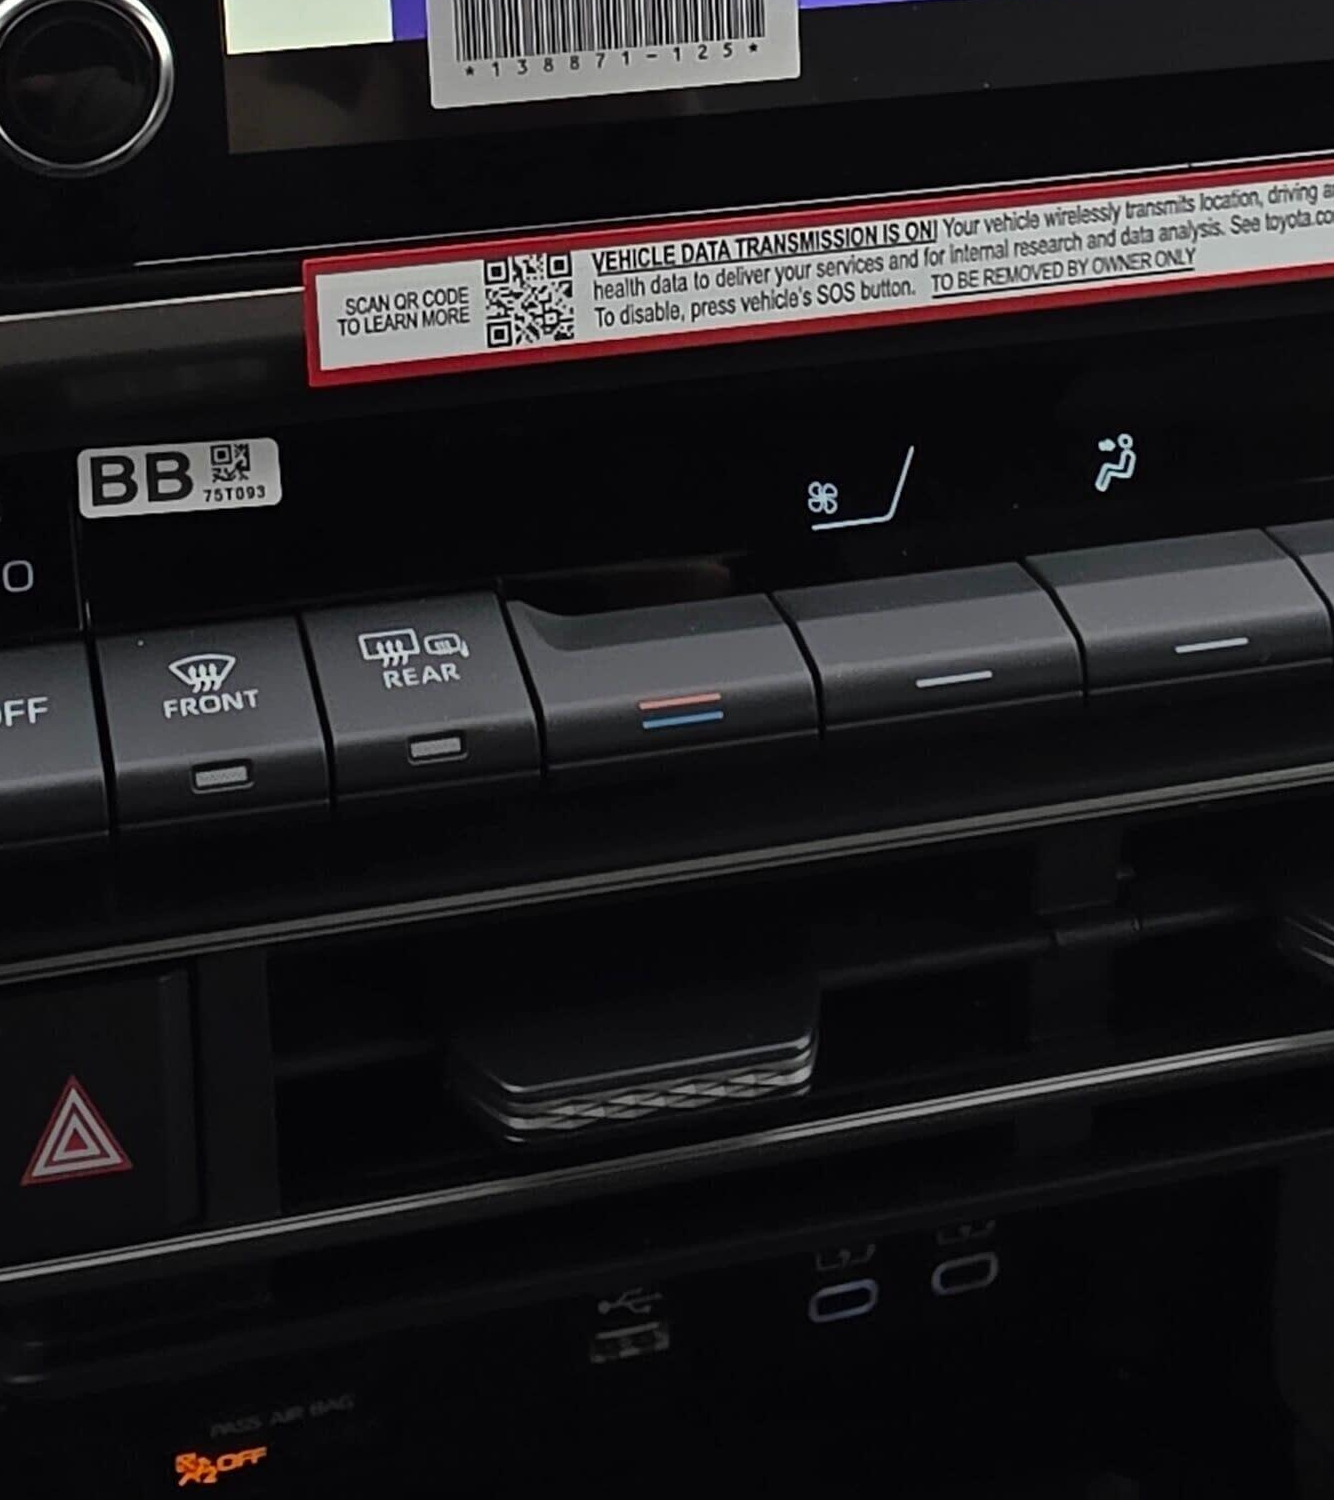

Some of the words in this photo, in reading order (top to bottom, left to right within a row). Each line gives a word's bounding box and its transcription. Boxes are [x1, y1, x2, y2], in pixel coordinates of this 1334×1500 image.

[592, 244, 675, 272] VEHICLE
[681, 240, 731, 263] DATA
[735, 225, 877, 255] TRANSMISSION
[883, 223, 900, 242] IS
[943, 218, 979, 237] Your
[984, 211, 1040, 233] vehicle
[1044, 203, 1121, 226] wirelessly
[1125, 195, 1196, 219] transmits
[1200, 189, 1263, 210] location,
[1268, 183, 1317, 205] driving
[593, 275, 645, 301] health
[651, 273, 688, 295] data
[693, 272, 710, 290] to
[717, 266, 771, 288] deliver
[775, 263, 811, 287] your
[817, 254, 884, 278] services
[889, 251, 918, 270] and
[923, 247, 945, 267] for
[950, 240, 1009, 263] internal
[1014, 233, 1082, 256] research
[1087, 229, 1116, 248] and
[1120, 226, 1154, 246] data
[1159, 218, 1225, 243] analysis.
[1230, 215, 1261, 235] See
[345, 295, 390, 316] SCAN
[394, 291, 419, 311] QR
[423, 287, 469, 307] CODE
[595, 307, 615, 328] To
[620, 300, 686, 325] disable,
[691, 300, 736, 323] press
[741, 287, 812, 312] vehicle's
[817, 282, 855, 304] SOS
[861, 278, 916, 299] button.
[931, 273, 953, 293] TO
[958, 269, 979, 289] BE
[983, 261, 1064, 286] REMOVED
[1068, 256, 1089, 277] BY
[1092, 251, 1153, 275] OWNER
[1154, 248, 1196, 268] ONLY
[338, 318, 360, 336] TO
[364, 312, 418, 333] LEARN
[422, 307, 470, 327] MORE
[89, 451, 194, 506] BB
[202, 484, 267, 503] 75T093
[382, 661, 461, 688] REAR
[163, 689, 259, 719] FRONT
[217, 1445, 268, 1472] OFF
